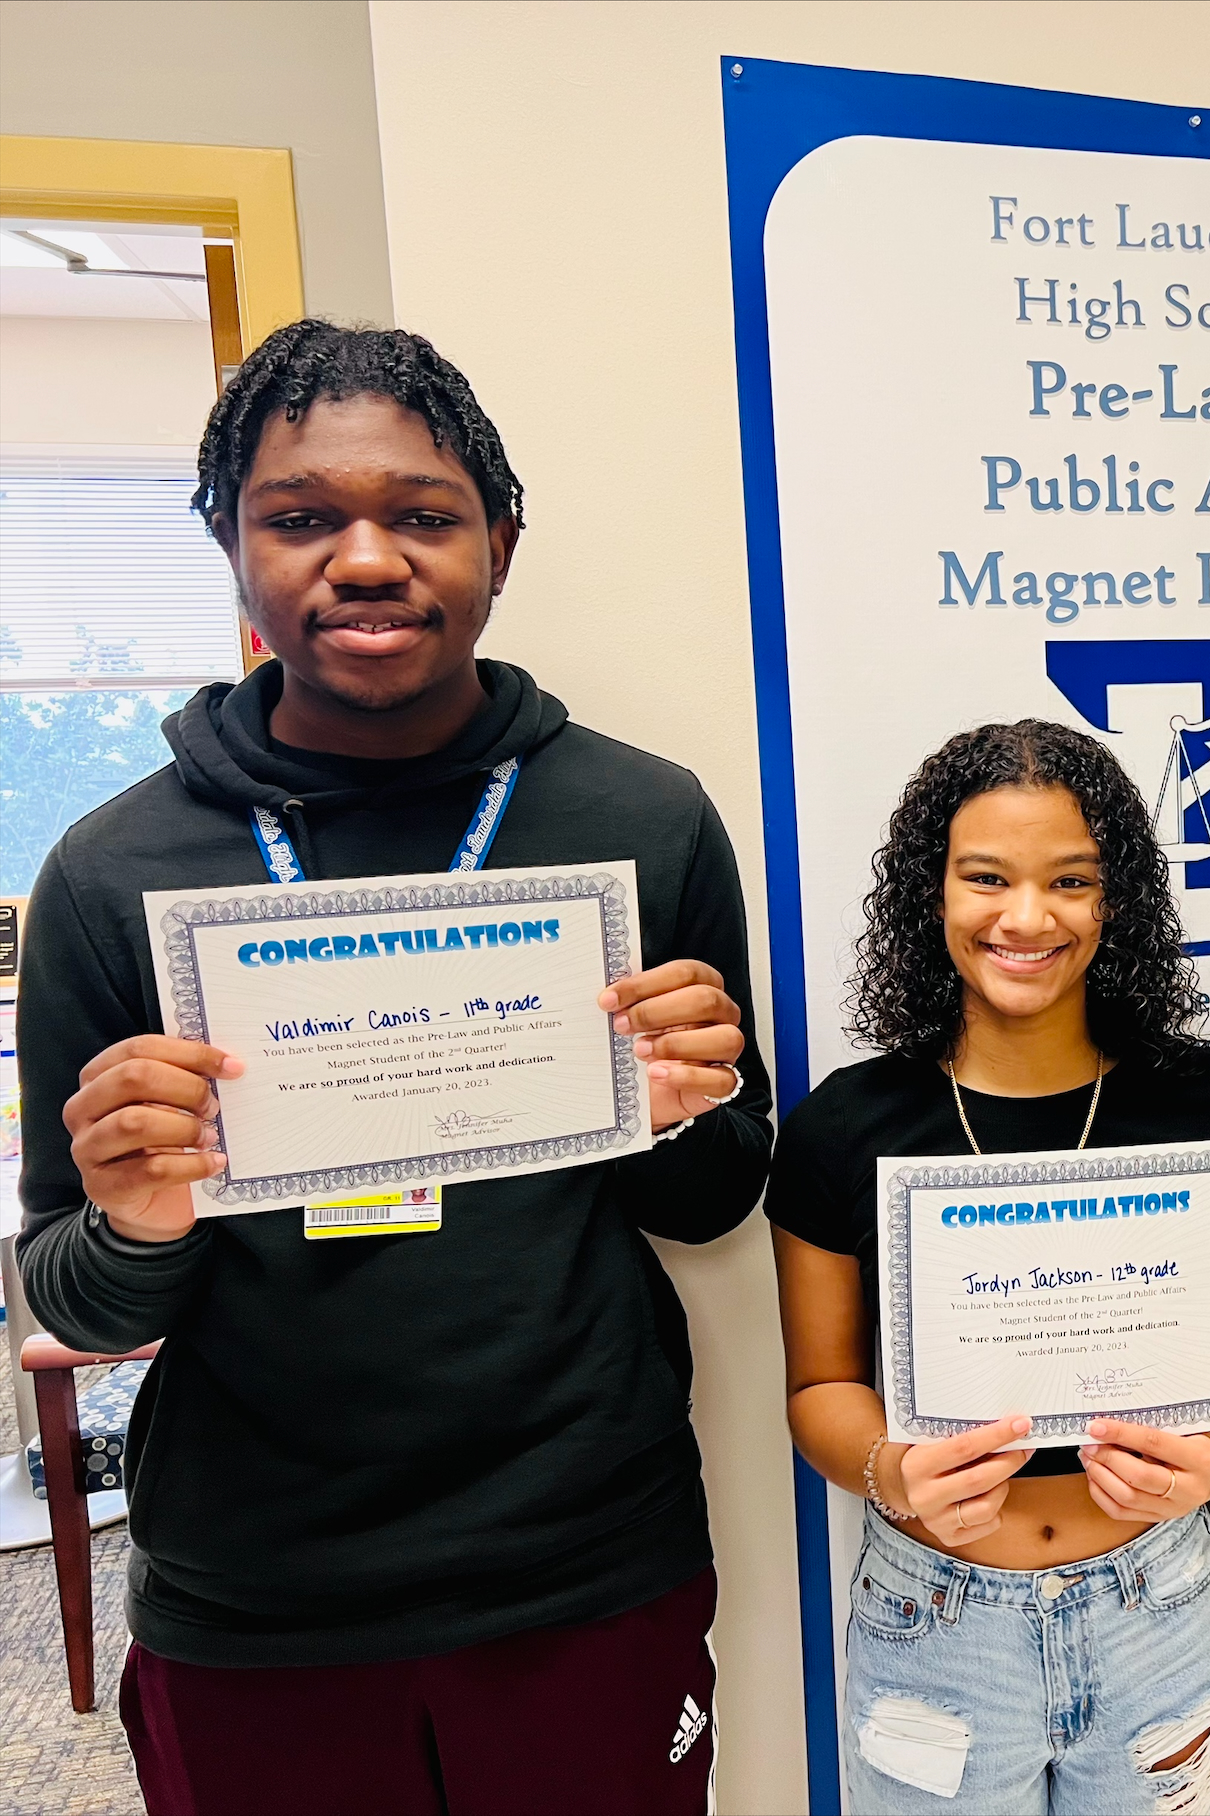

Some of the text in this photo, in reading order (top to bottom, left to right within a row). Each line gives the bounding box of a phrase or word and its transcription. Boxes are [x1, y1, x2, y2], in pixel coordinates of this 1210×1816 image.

[989, 196, 1094, 246] Fort
[1015, 277, 1144, 341] High
[981, 455, 1175, 515] Public
[938, 551, 1176, 624] Magnet
[451, 852, 478, 873] ort
[466, 783, 507, 854] Lauderdale
[267, 843, 299, 884] High
[237, 919, 560, 968] CONGRATULATIONS
[266, 1015, 354, 1043] Valdimir
[368, 1005, 430, 1030] Canois
[496, 993, 542, 1020] grade
[262, 1048, 285, 1056] You
[287, 1046, 313, 1054] have
[316, 1043, 342, 1051] been
[346, 1037, 389, 1049] selected
[407, 1034, 424, 1043] the
[427, 1031, 467, 1041] Pre-Law
[471, 1026, 490, 1036] and
[493, 1023, 524, 1033] Public
[527, 1020, 562, 1029] Affairs
[327, 1058, 366, 1068] Magnet
[369, 1054, 409, 1064] Student
[413, 1050, 424, 1060] of
[428, 1049, 444, 1058] the
[464, 1043, 506, 1054] Quarter!
[320, 1080, 333, 1088] so
[336, 1074, 369, 1087] proud
[372, 1072, 384, 1081] of
[387, 1071, 413, 1081] your
[416, 1066, 441, 1077] hard
[444, 1063, 472, 1073] work
[475, 1060, 495, 1069] and
[498, 1055, 555, 1067] dedication.
[351, 1078, 492, 1101] Awarded January 20, 2023.
[940, 1190, 1190, 1229] CONGRATULATIONS
[950, 1302, 967, 1310] You
[970, 1301, 990, 1309] have
[993, 1299, 1013, 1308] been
[1016, 1297, 1051, 1307] selected
[1065, 1295, 1079, 1304] the
[1081, 1294, 1113, 1302] Pre-Law
[1115, 1290, 1131, 1299] and
[1133, 1288, 1157, 1298] Public
[1159, 1285, 1186, 1294] Affairs
[962, 1272, 1021, 1297] Jordyn
[1111, 1263, 1136, 1281] 12th
[1140, 1259, 1179, 1284] grade
[959, 1335, 972, 1343] We
[1004, 1331, 1031, 1342] proud
[1034, 1330, 1043, 1339] of
[1046, 1331, 1067, 1339] your
[1069, 1327, 1089, 1336] hard
[1092, 1326, 1114, 1334] work
[1117, 1324, 1132, 1332] and
[999, 1316, 1030, 1325] Magnet
[1033, 1313, 1065, 1323] Student
[1068, 1311, 1078, 1320] of
[1080, 1311, 1093, 1319] the
[1015, 1346, 1053, 1356] Awarded
[1055, 1346, 1088, 1355] January
[669, 1711, 708, 1763] adidas
